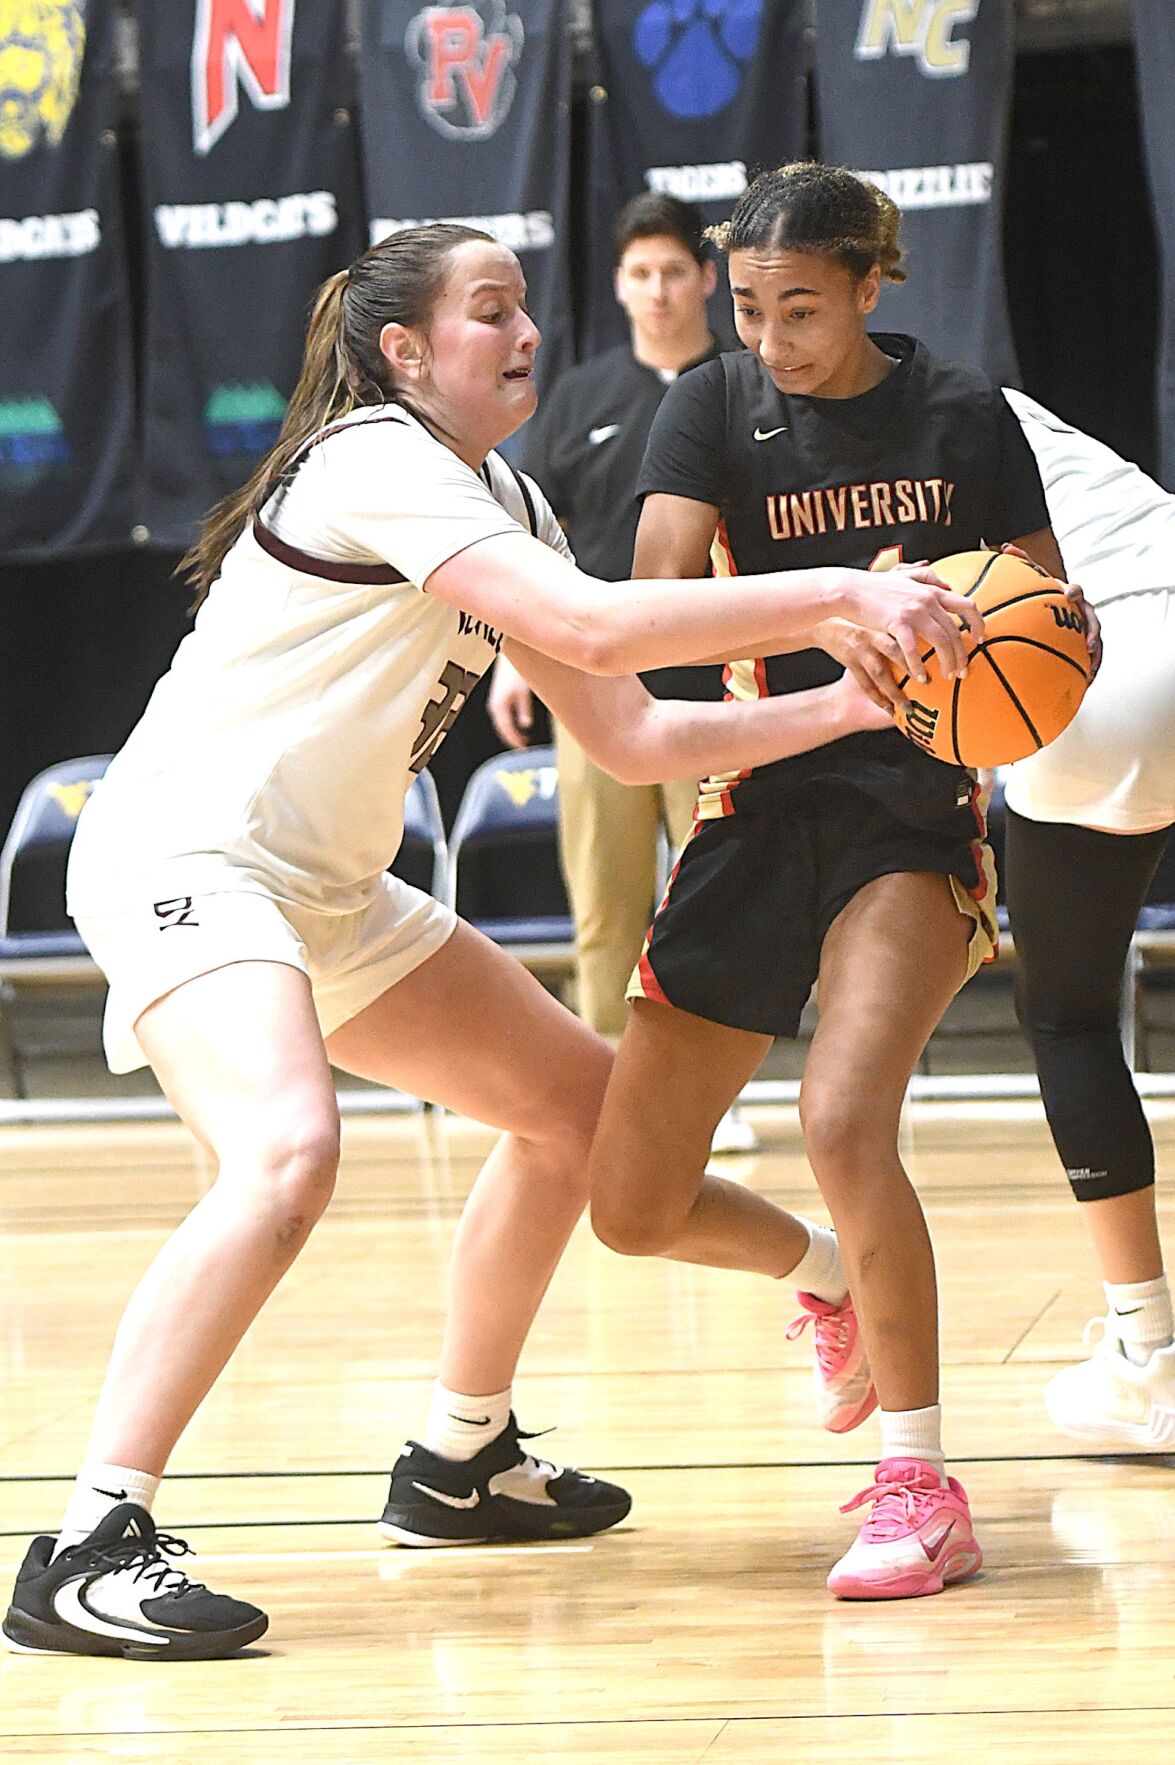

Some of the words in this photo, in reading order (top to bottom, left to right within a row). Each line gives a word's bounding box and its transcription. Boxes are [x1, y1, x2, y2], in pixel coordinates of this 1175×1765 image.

[421, 6, 513, 128] PV
[854, 0, 980, 78] NC
[154, 191, 340, 249] WILDCATS
[766, 477, 955, 540] UNIVERSITY
